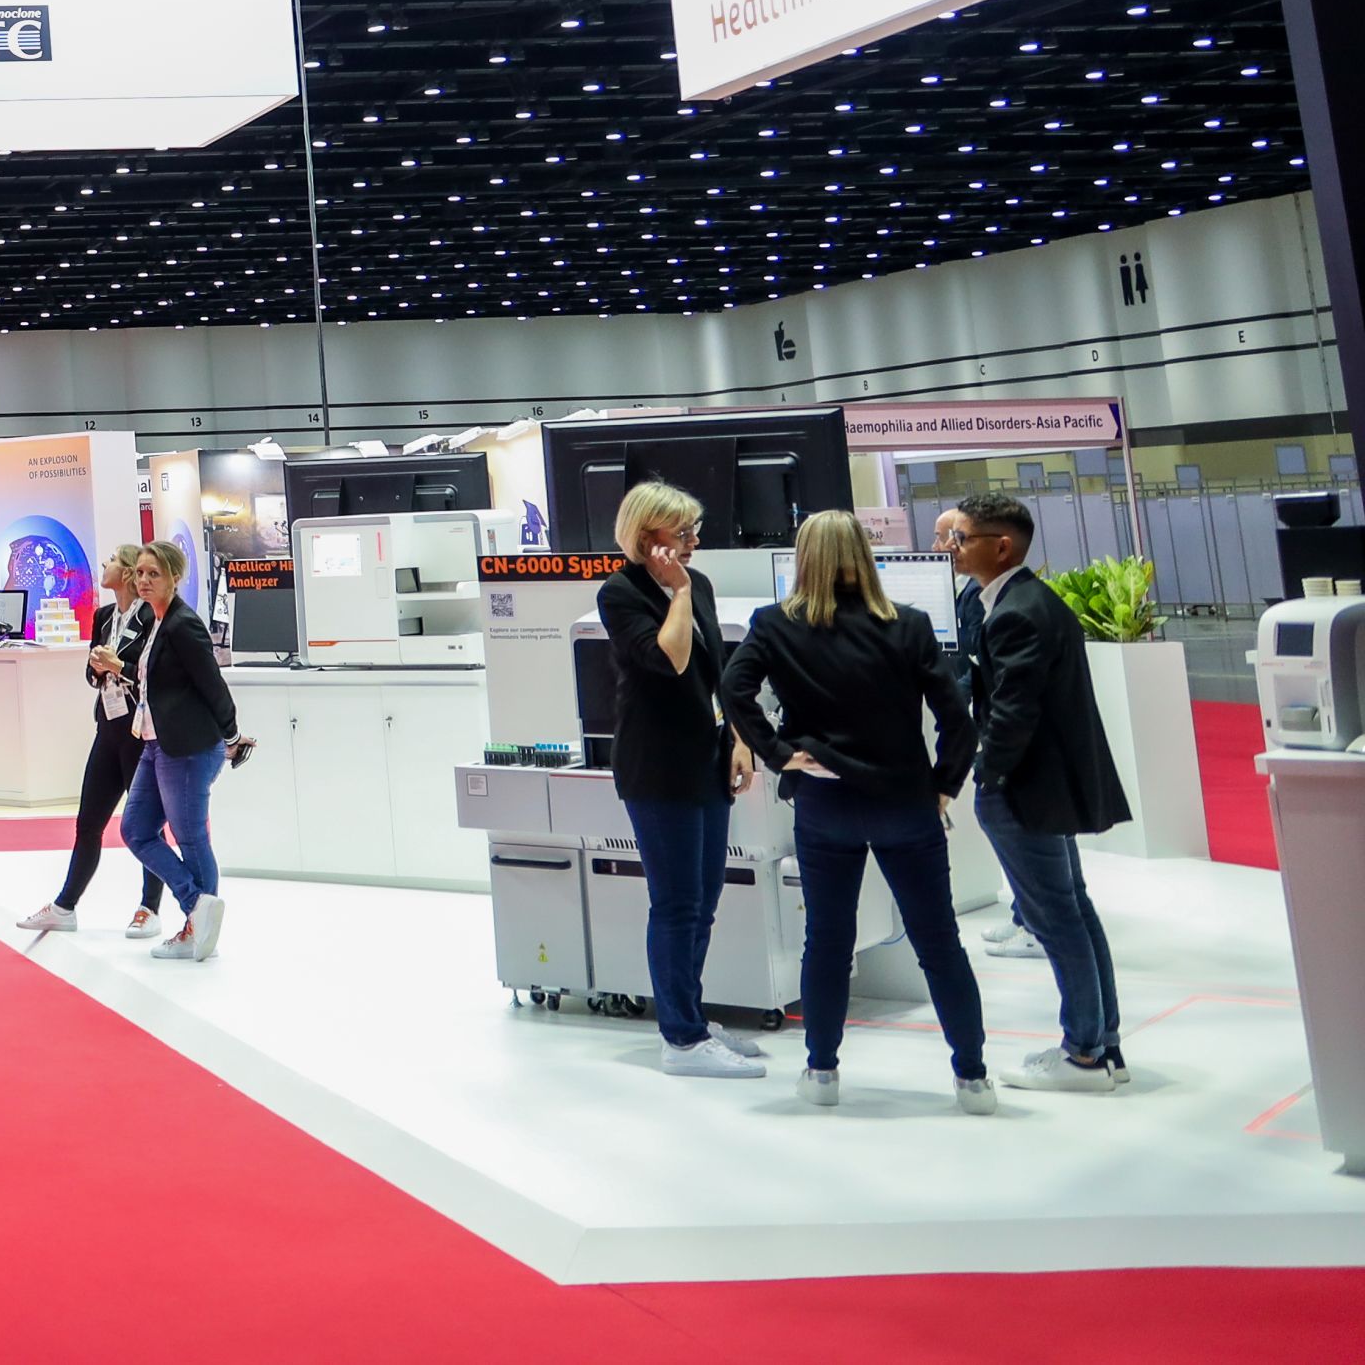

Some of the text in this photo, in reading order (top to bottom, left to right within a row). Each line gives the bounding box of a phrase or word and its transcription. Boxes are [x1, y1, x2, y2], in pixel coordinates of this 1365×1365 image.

[1238, 330, 1246, 344] E
[1091, 349, 1099, 363] D
[979, 363, 986, 376] C
[863, 380, 869, 391] B
[781, 393, 787, 403] A
[417, 409, 429, 421] 15
[531, 405, 544, 417] 16
[191, 417, 203, 427] 13
[308, 413, 320, 424] 14
[916, 418, 938, 433] and
[940, 416, 974, 432] Allied
[976, 413, 1062, 431] Disorders-Asia
[1064, 414, 1104, 430] Pacific
[85, 421, 96, 431] 12
[28, 454, 78, 467] AN EXPLOSION
[28, 467, 87, 480] OF POSSIBILITIES
[480, 555, 564, 575] CN-6000
[228, 575, 279, 591] Analyzer
[489, 627, 509, 635] Explore
